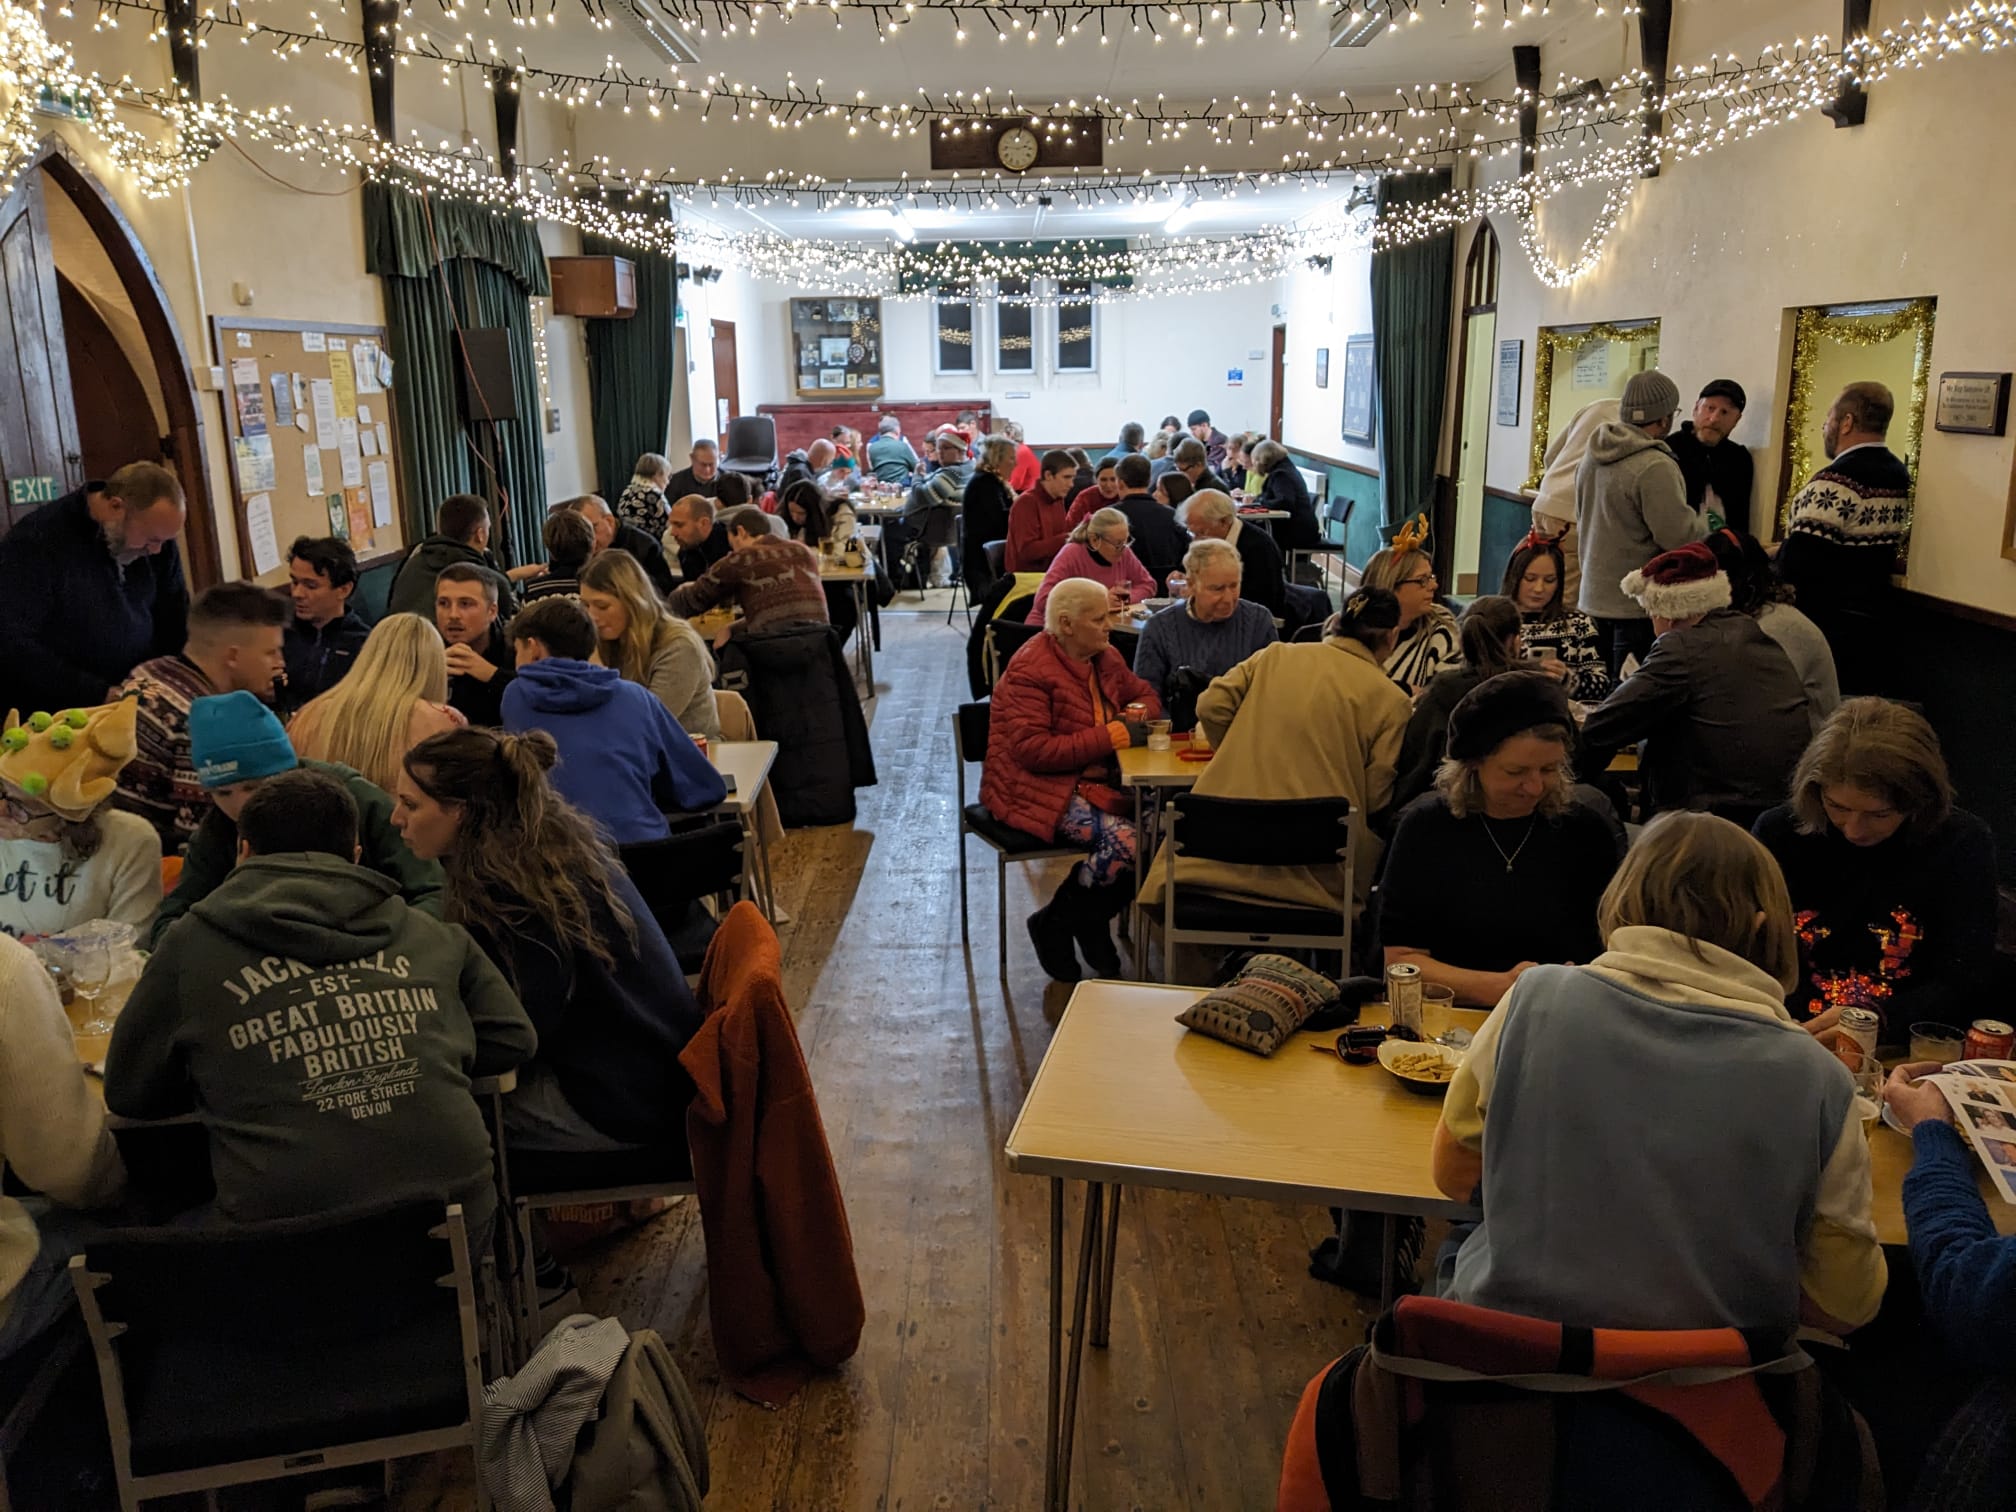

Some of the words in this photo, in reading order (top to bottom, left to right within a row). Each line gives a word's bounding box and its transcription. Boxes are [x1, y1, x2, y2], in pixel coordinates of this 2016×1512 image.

[13, 477, 52, 503] EXIT
[44, 862, 81, 905] it
[223, 954, 315, 1005] JACK
[228, 1001, 319, 1051] GREAT
[336, 987, 438, 1020] BRITAIN
[268, 1013, 418, 1063] FABULOUSLY
[303, 1041, 406, 1079] BRITISH
[316, 1098, 336, 1113] 22
[337, 1089, 369, 1108] FORE
[371, 1081, 416, 1100] STREET
[352, 1100, 392, 1120] DEVON
